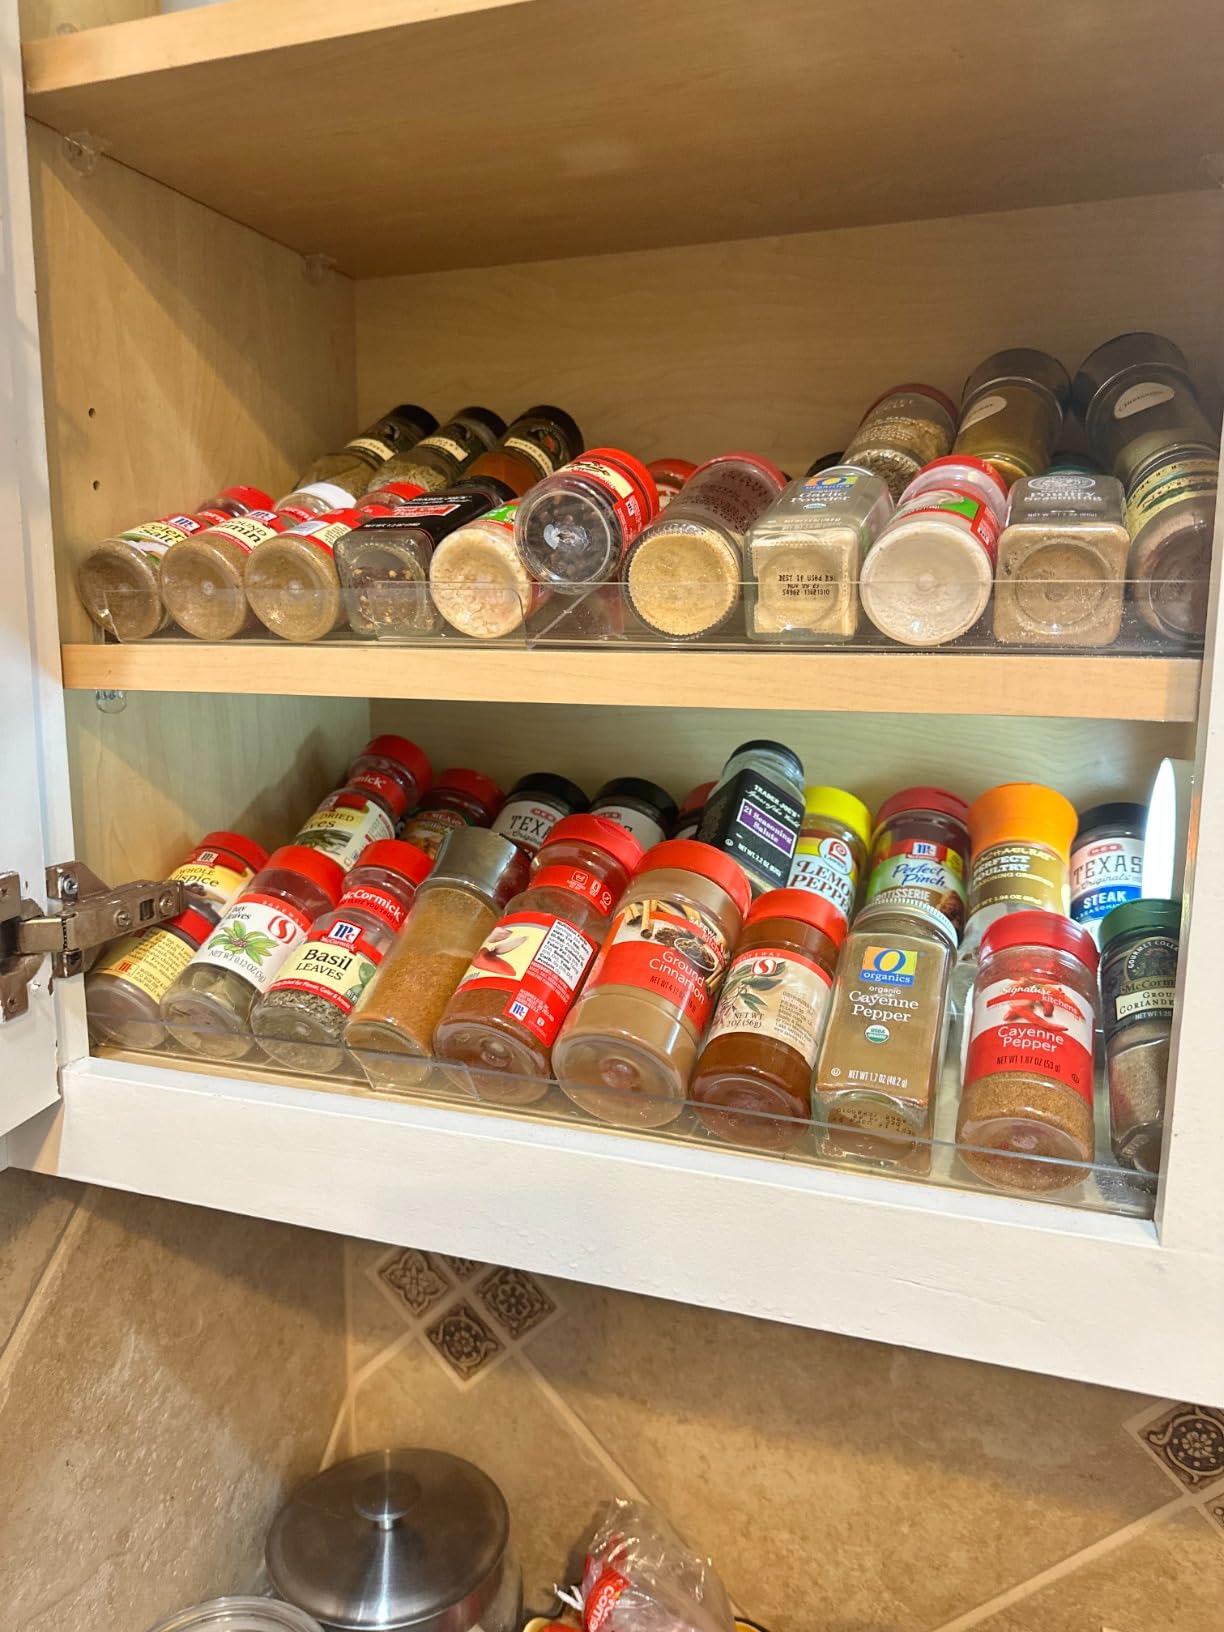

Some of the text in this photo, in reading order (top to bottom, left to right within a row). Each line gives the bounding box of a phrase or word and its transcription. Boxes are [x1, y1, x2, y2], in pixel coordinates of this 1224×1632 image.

[754, 784, 780, 805] TRADER
[752, 811, 793, 845] Seasoning
[753, 821, 780, 844] Salute
[796, 860, 850, 897] LEMO
[892, 863, 945, 879] Perfect
[1074, 855, 1142, 885] TEXAS
[171, 873, 220, 887] llspice
[901, 873, 946, 887] Pinch
[343, 889, 402, 923] McCormick
[366, 901, 379, 910] YOU
[1083, 890, 1128, 910] STEAK
[302, 948, 354, 972] Basil
[1128, 940, 1152, 969] GOURMET
[296, 962, 344, 981] LEAVES
[662, 950, 704, 986] Ground
[863, 971, 910, 983] organics
[649, 958, 705, 1004] Cinnamon
[868, 986, 902, 995] organic
[1002, 984, 1054, 996] Signature
[849, 990, 920, 1010] Cayenne
[1042, 994, 1078, 1014] kitchens
[1120, 998, 1174, 1015] CORIANDE
[852, 1004, 912, 1022] Pepper
[1135, 1012, 1146, 1020] NET
[998, 1026, 1064, 1046] Cayenne
[1003, 1036, 1058, 1053] Pepper
[996, 1056, 1008, 1065] NET
[1008, 1056, 1018, 1064] WT
[1034, 1057, 1044, 1066] OZ
[848, 1069, 859, 1079] NET
[860, 1070, 869, 1080] WT
[870, 1072, 878, 1082] 1.7
[878, 1074, 887, 1084] OZ
